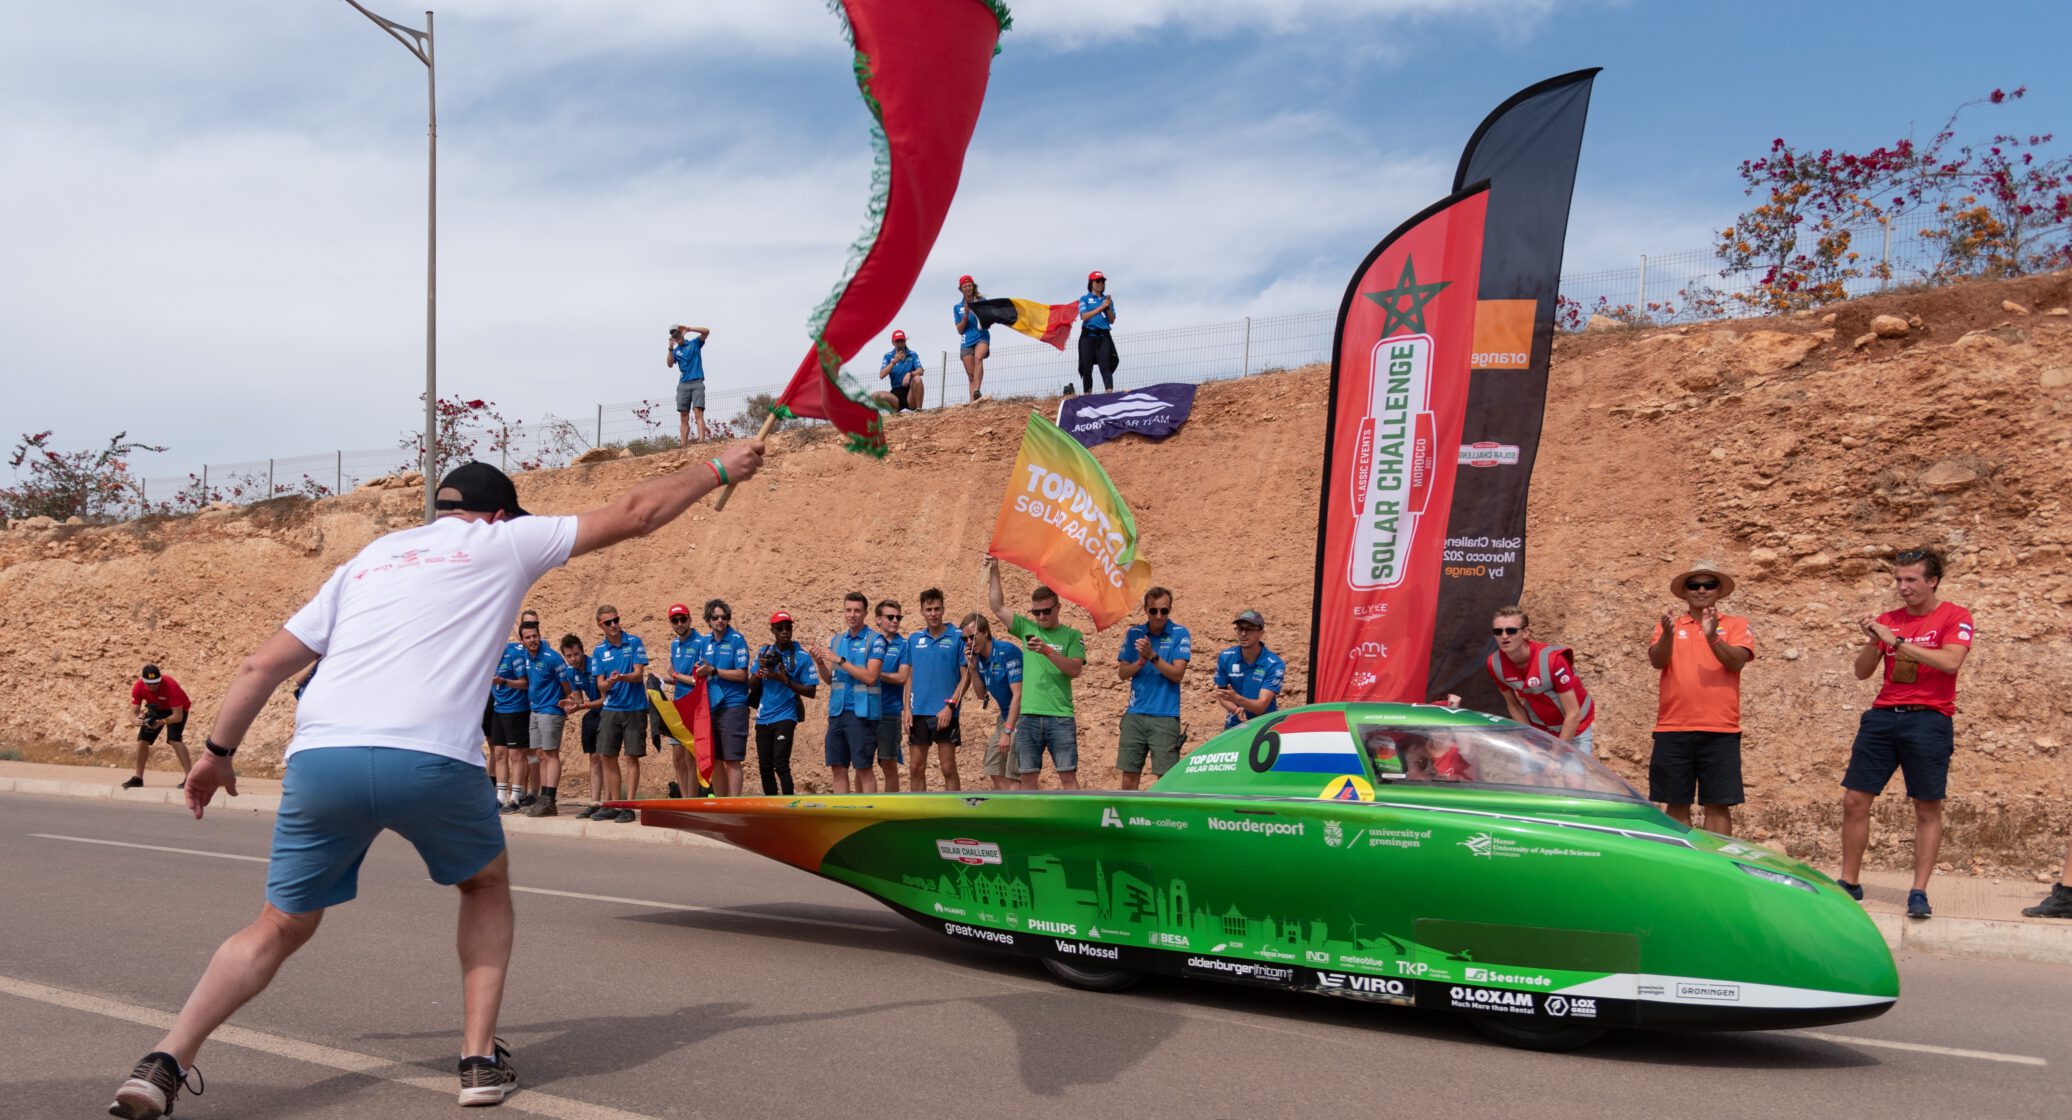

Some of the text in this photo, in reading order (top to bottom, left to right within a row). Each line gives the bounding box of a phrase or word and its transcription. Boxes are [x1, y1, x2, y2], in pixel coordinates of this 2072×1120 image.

[1357, 429, 1371, 503] CLASSIC EVENTS
[1371, 343, 1415, 580] SOLAR CHALLENGE
[1412, 438, 1426, 488] MOROCCO
[1027, 463, 1075, 503] TOP
[1014, 494, 1123, 588] SOLAR RACING
[1248, 714, 1290, 774] 6
[1189, 751, 1239, 765] TOP DUTCH
[1185, 765, 1208, 773] SOLAR
[1208, 817, 1304, 836] Noorderpoort
[1369, 827, 1432, 839] university of
[1369, 838, 1420, 848] groningen
[1493, 845, 1529, 853] University
[961, 848, 999, 858] CHALLENGE
[1028, 919, 1077, 935] PHILIPS
[1160, 933, 1190, 945] BESA
[1055, 939, 1119, 959] Van Mossel
[1340, 956, 1383, 967] meteoblue
[1396, 960, 1428, 976] TKP
[1349, 975, 1405, 995] VIRO
[1489, 971, 1552, 986] Seatrade
[1681, 987, 1736, 997] GRONINGEN
[1451, 1000, 1535, 1014] Much More than Rental
[1571, 998, 1597, 1008] LOX
